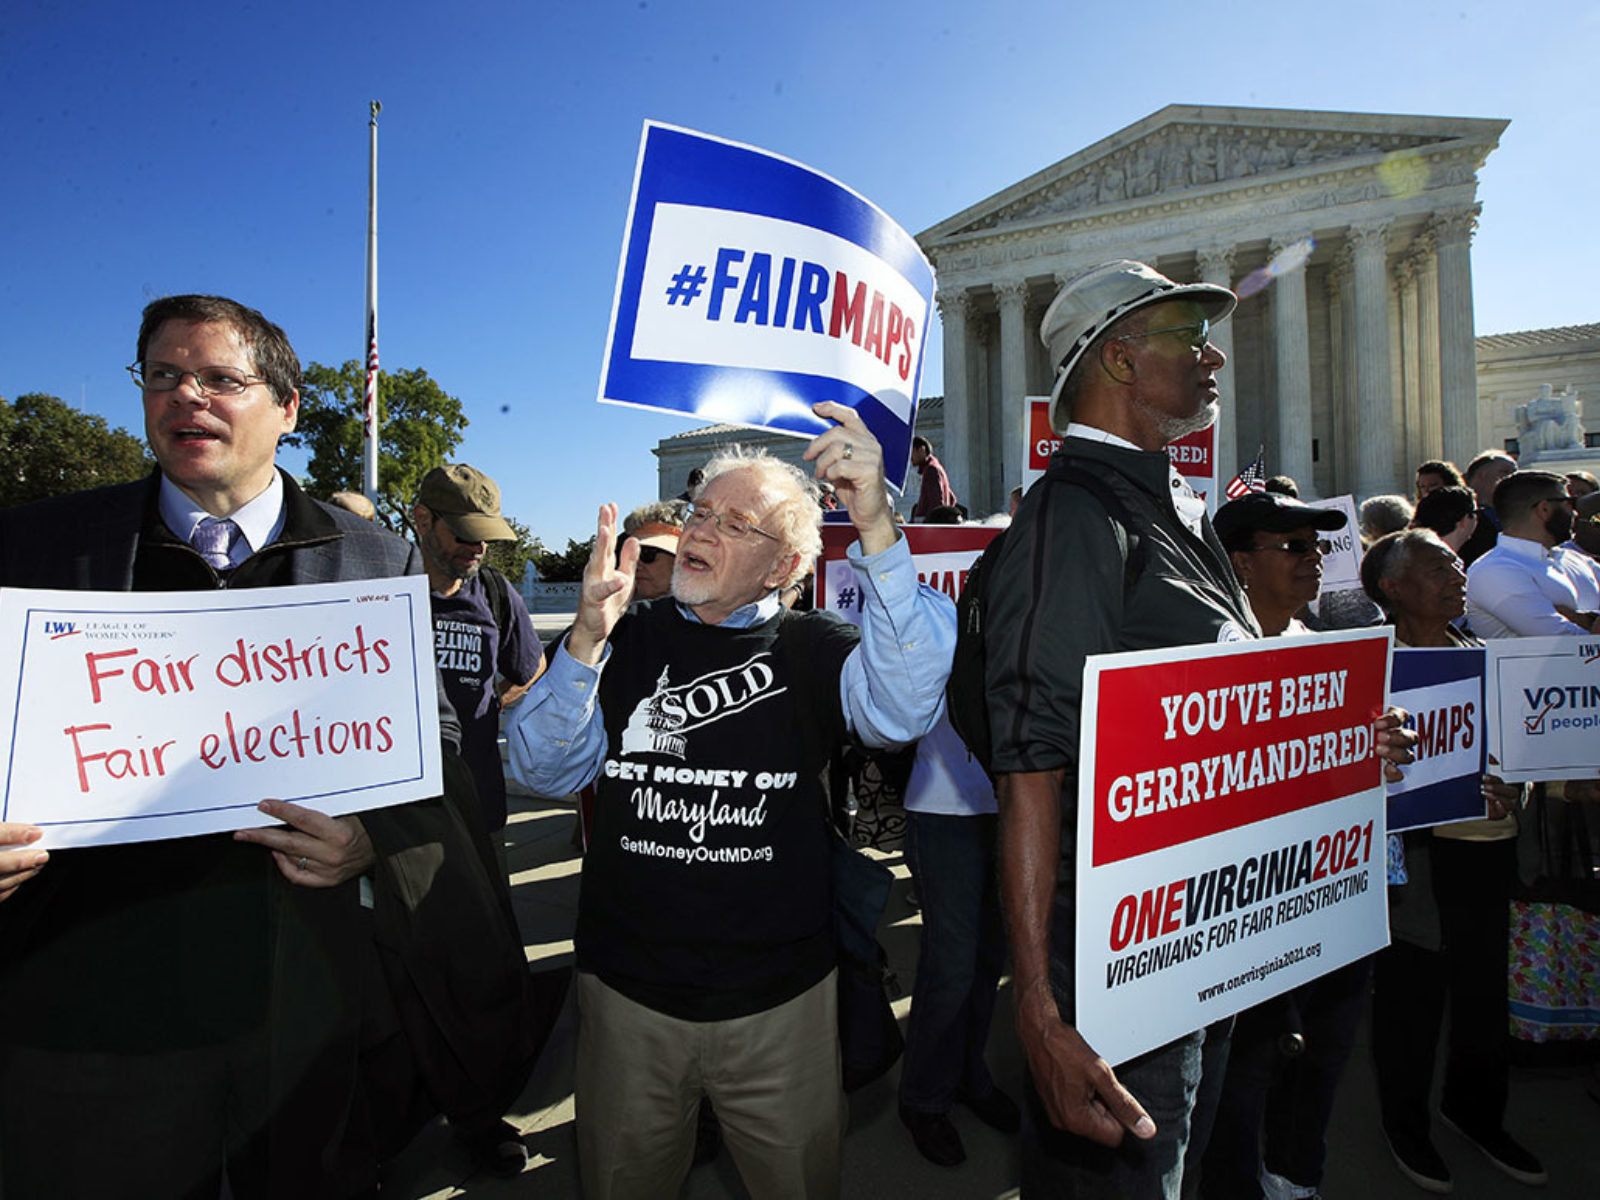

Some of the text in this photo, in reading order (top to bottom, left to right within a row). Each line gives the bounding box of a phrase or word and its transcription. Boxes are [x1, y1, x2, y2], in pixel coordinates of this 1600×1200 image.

[665, 247, 915, 381] #FAIRMAPS
[45, 621, 76, 634] LWV
[435, 631, 482, 653] UNITE
[85, 624, 391, 704] Fair districts
[437, 650, 482, 673] CITIZ
[661, 662, 774, 728] SOLD
[1161, 669, 1349, 741] YOU'VE BEEN
[1551, 714, 1600, 731] peopl
[64, 710, 392, 793] Fair elections
[604, 759, 648, 782] GET
[653, 765, 748, 789] MONEY
[1107, 722, 1375, 823] GERRYMANDERED!
[630, 786, 767, 844] Maryland
[620, 835, 773, 864] GetMoneyOutMD.org
[1109, 820, 1374, 952] ONEVIRGINIA2021
[1106, 869, 1369, 990] VIRGINIANS FOR FAIR REDISTRICTING
[1197, 942, 1322, 1003] www.onevirginia2021.org
